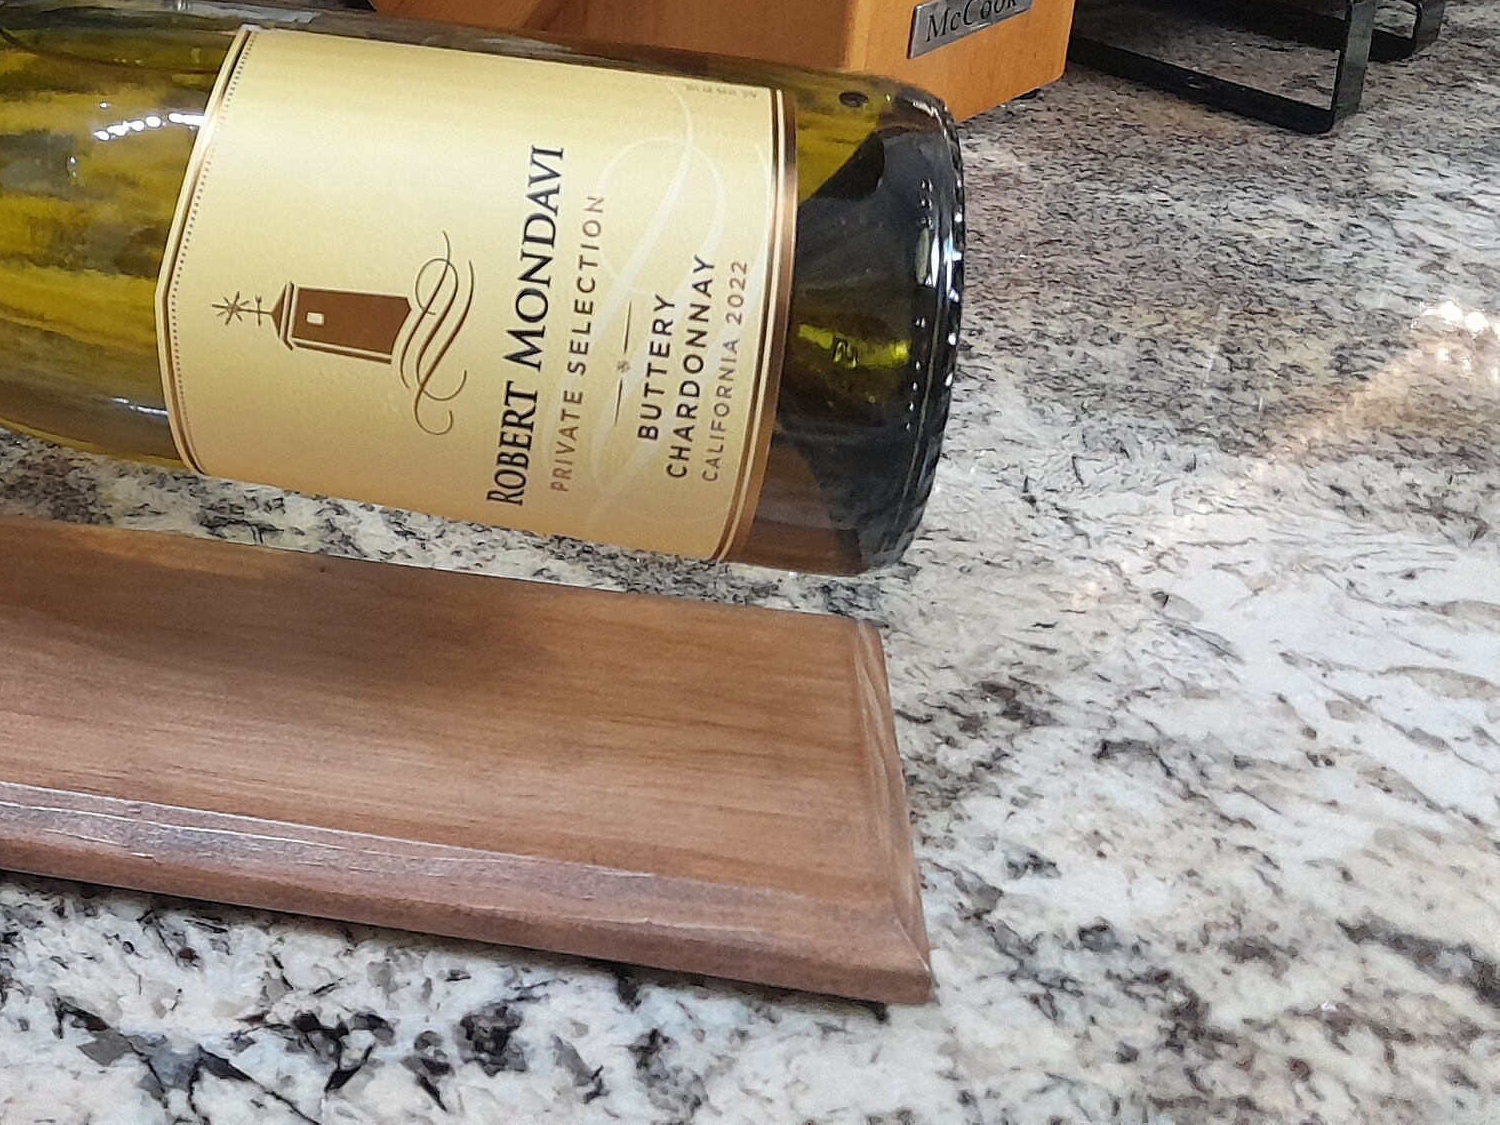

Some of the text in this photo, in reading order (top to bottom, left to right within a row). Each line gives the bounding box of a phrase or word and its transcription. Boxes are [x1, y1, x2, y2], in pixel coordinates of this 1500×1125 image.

[486, 145, 565, 506] ROBERT MONDAVI
[549, 195, 604, 492] PRIVATE SELECTION
[638, 292, 676, 440] BUTTERY
[667, 255, 715, 479] CHARDONNAY
[702, 260, 748, 482] CALIFORNIA 2022
